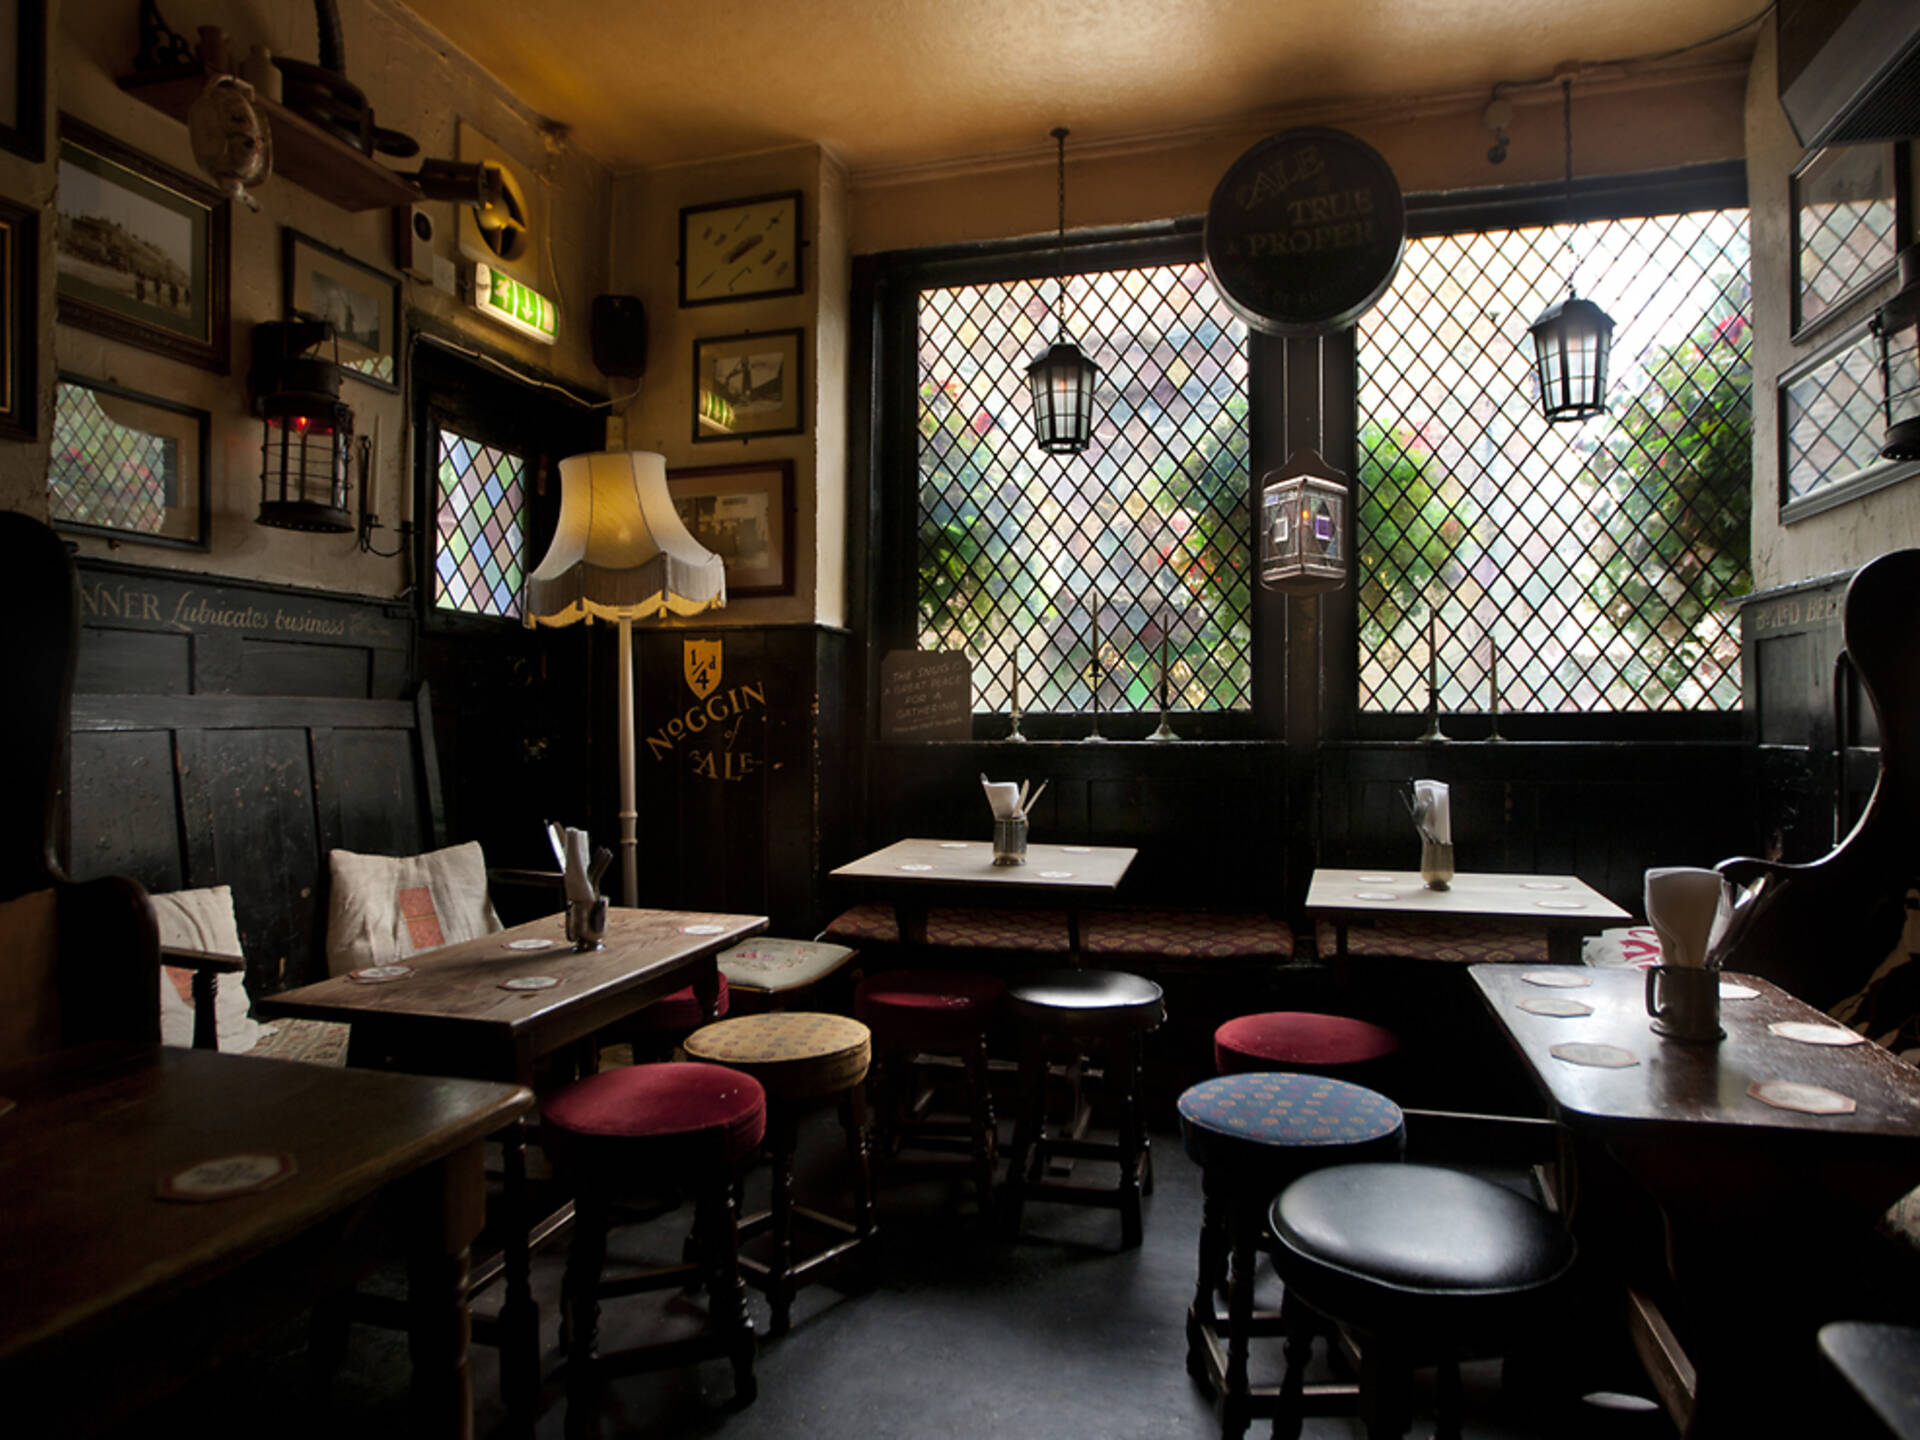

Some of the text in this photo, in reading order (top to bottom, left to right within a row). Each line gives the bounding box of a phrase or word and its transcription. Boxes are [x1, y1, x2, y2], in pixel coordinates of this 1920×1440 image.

[1287, 187, 1373, 226] TRUE
[170, 590, 269, 632] Lubricates
[274, 608, 345, 637] business
[904, 693, 927, 704] FOR
[688, 749, 755, 782] ALE
